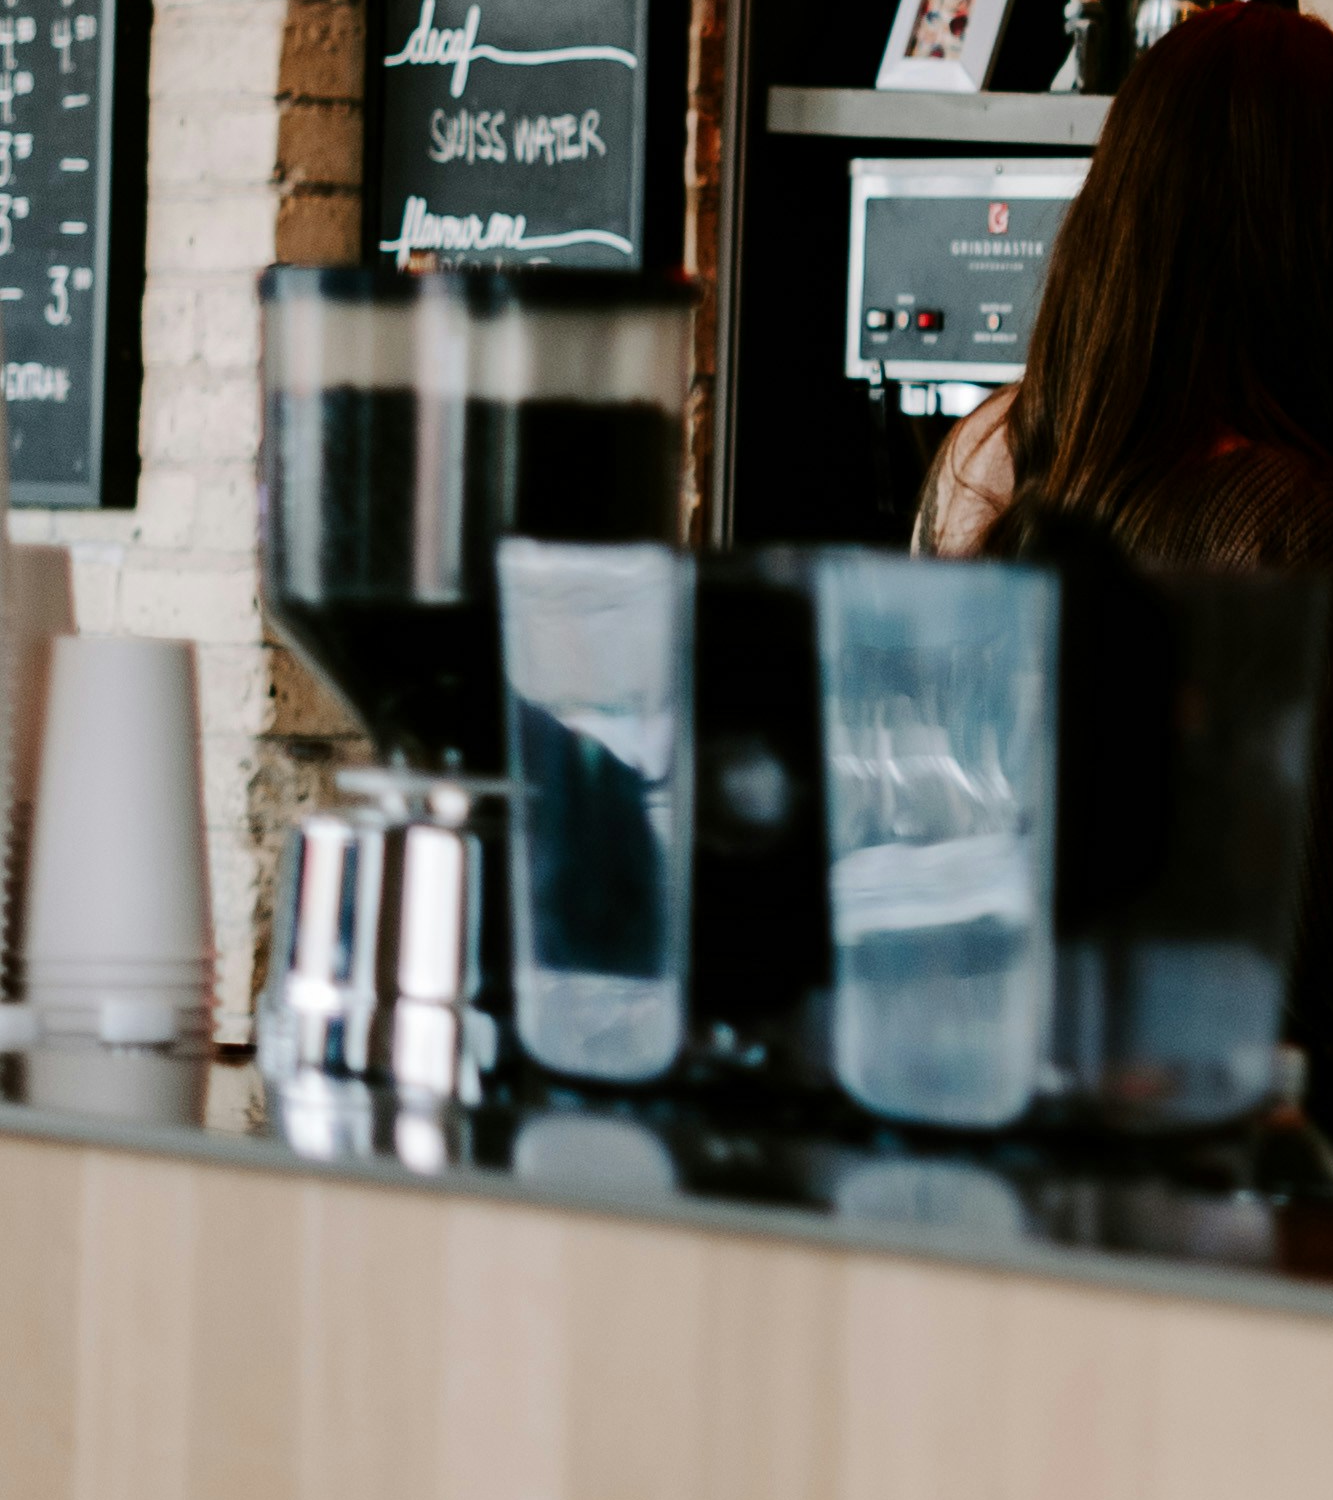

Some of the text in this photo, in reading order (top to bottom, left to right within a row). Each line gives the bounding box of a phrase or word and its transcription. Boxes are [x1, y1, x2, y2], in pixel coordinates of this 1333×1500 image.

[429, 108, 606, 166] SWISS WATER
[951, 242, 1043, 256] GRINDMASTER
